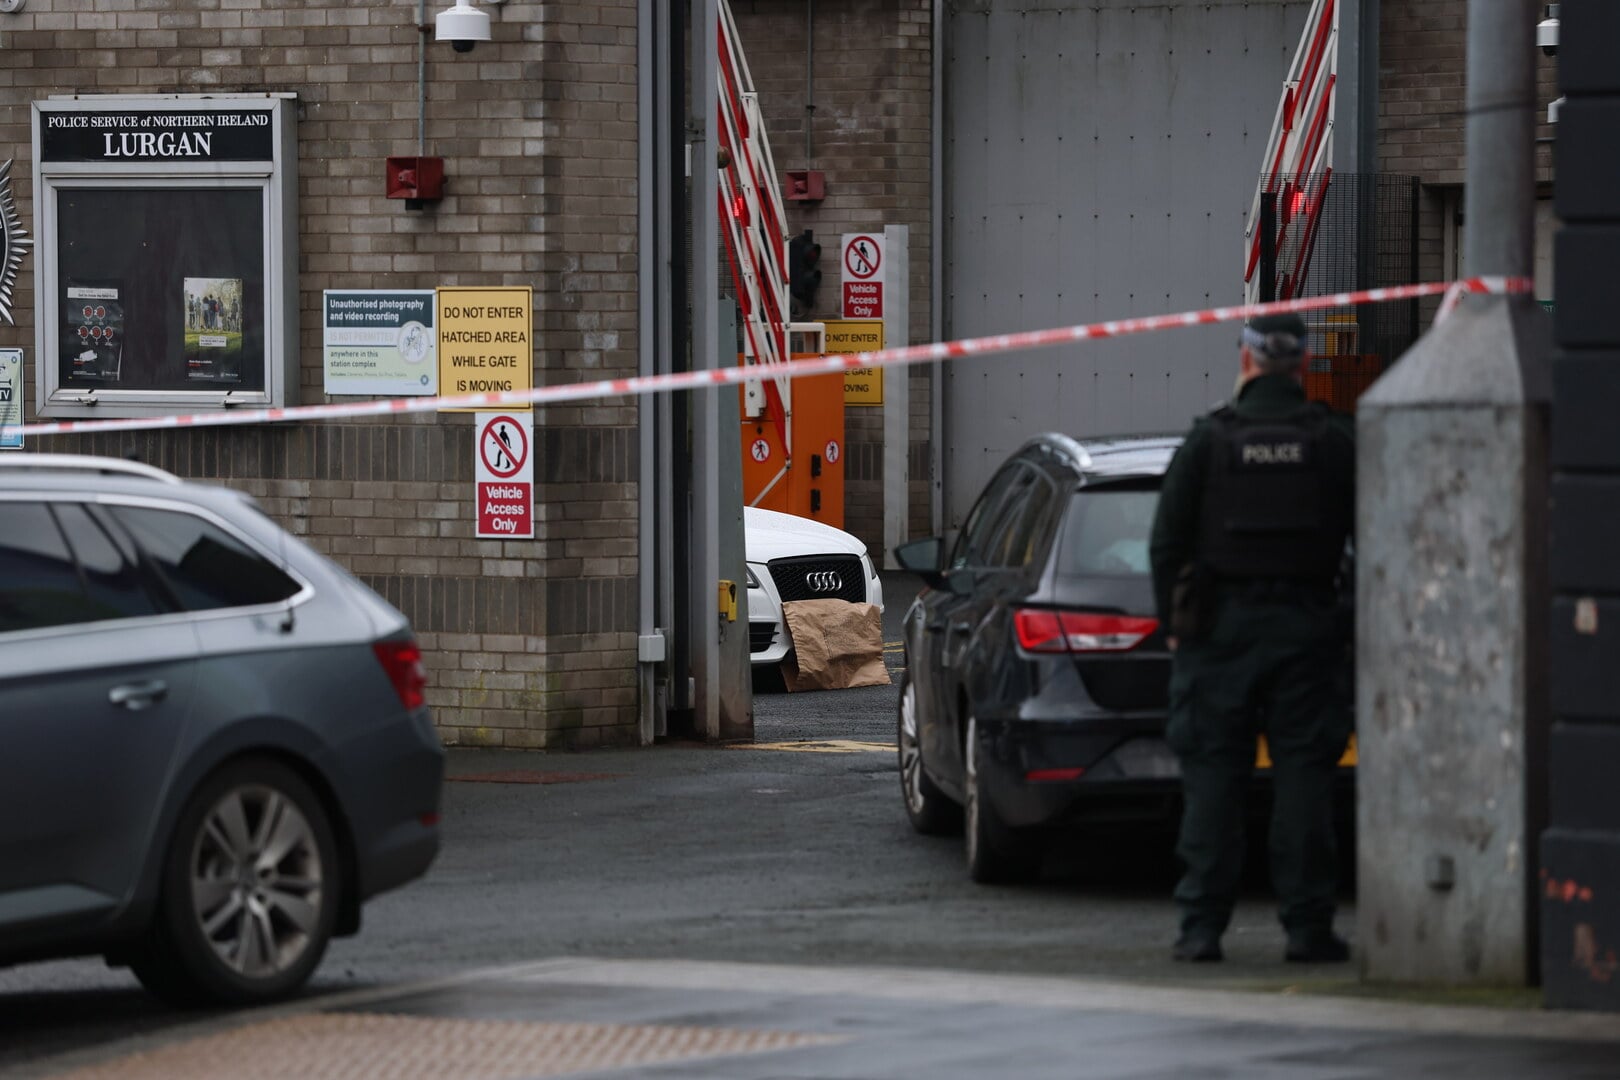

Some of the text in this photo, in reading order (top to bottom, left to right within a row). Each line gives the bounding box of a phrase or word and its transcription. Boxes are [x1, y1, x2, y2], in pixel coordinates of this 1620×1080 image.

[48, 114, 268, 128] POLICE SERVICE of NORTHERN IRELAND
[103, 131, 212, 157] LURGAN
[849, 284, 877, 294] Vehicle
[330, 299, 424, 311] Unauthorised photography
[848, 296, 878, 305] Access
[330, 312, 399, 323] and video recording
[444, 306, 524, 319] DO NOT ENTER
[853, 306, 872, 317] Only
[330, 331, 394, 342] IS NOT PERMITTED
[441, 331, 527, 343] HATCHED AREA
[832, 333, 849, 342] NOT
[851, 333, 878, 342] ENTER
[330, 360, 376, 369] station complex
[451, 355, 517, 368] WHILE GATE
[851, 367, 873, 376] GATE
[456, 380, 512, 392] IS MOVING
[844, 384, 869, 393] OVING
[1242, 443, 1302, 464] POLICE
[486, 486, 523, 499] Vehicle
[485, 501, 524, 515] Access
[492, 517, 517, 534] Only
